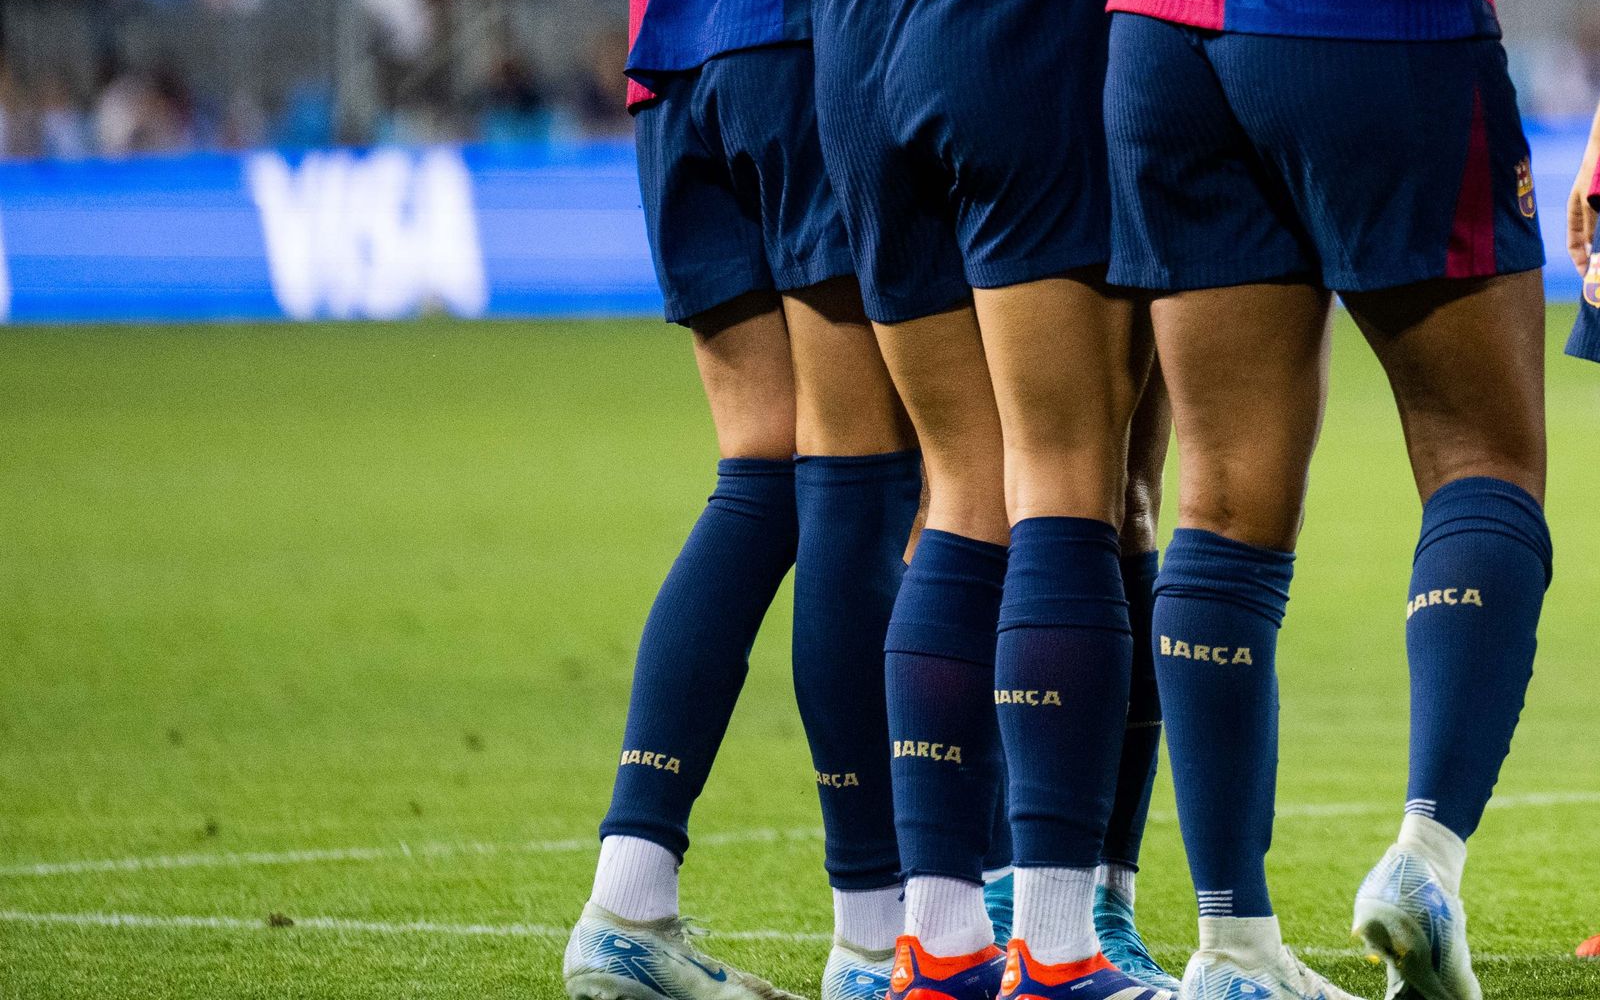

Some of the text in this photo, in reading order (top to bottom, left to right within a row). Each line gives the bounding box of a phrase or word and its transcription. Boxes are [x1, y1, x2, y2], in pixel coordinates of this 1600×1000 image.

[243, 147, 489, 319] VISA
[1160, 635, 1253, 665] BARÇA
[893, 741, 962, 764] BARÇA
